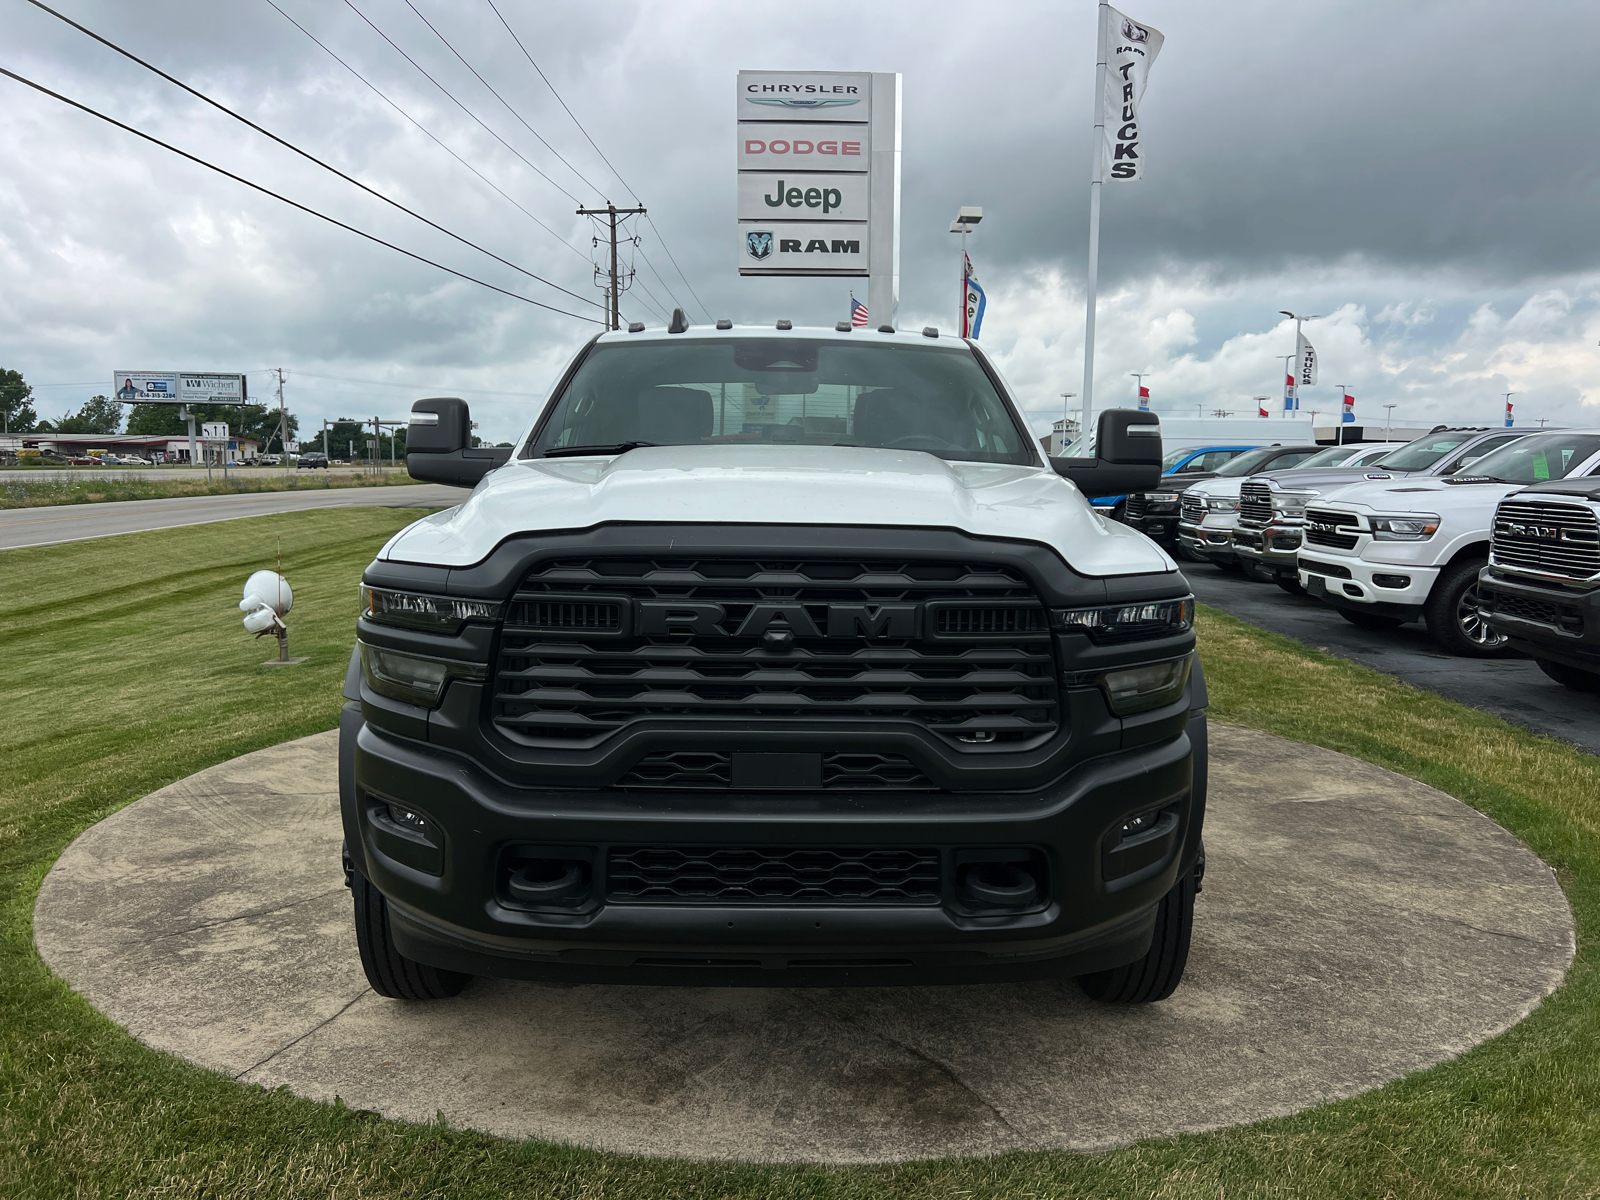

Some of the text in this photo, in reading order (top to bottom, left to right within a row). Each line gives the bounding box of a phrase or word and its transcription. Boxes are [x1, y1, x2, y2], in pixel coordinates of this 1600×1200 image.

[1116, 46, 1145, 57] RAM
[747, 84, 858, 94] CHRYSLER
[1110, 62, 1139, 179] TRUCKS
[745, 140, 861, 155] DODGE
[764, 180, 842, 214] Jeep
[779, 239, 860, 254] RAM
[1302, 351, 1314, 385] TRUCKS
[202, 380, 234, 388] Wichert
[1513, 524, 1557, 539] RAM
[639, 601, 922, 639] RAM
